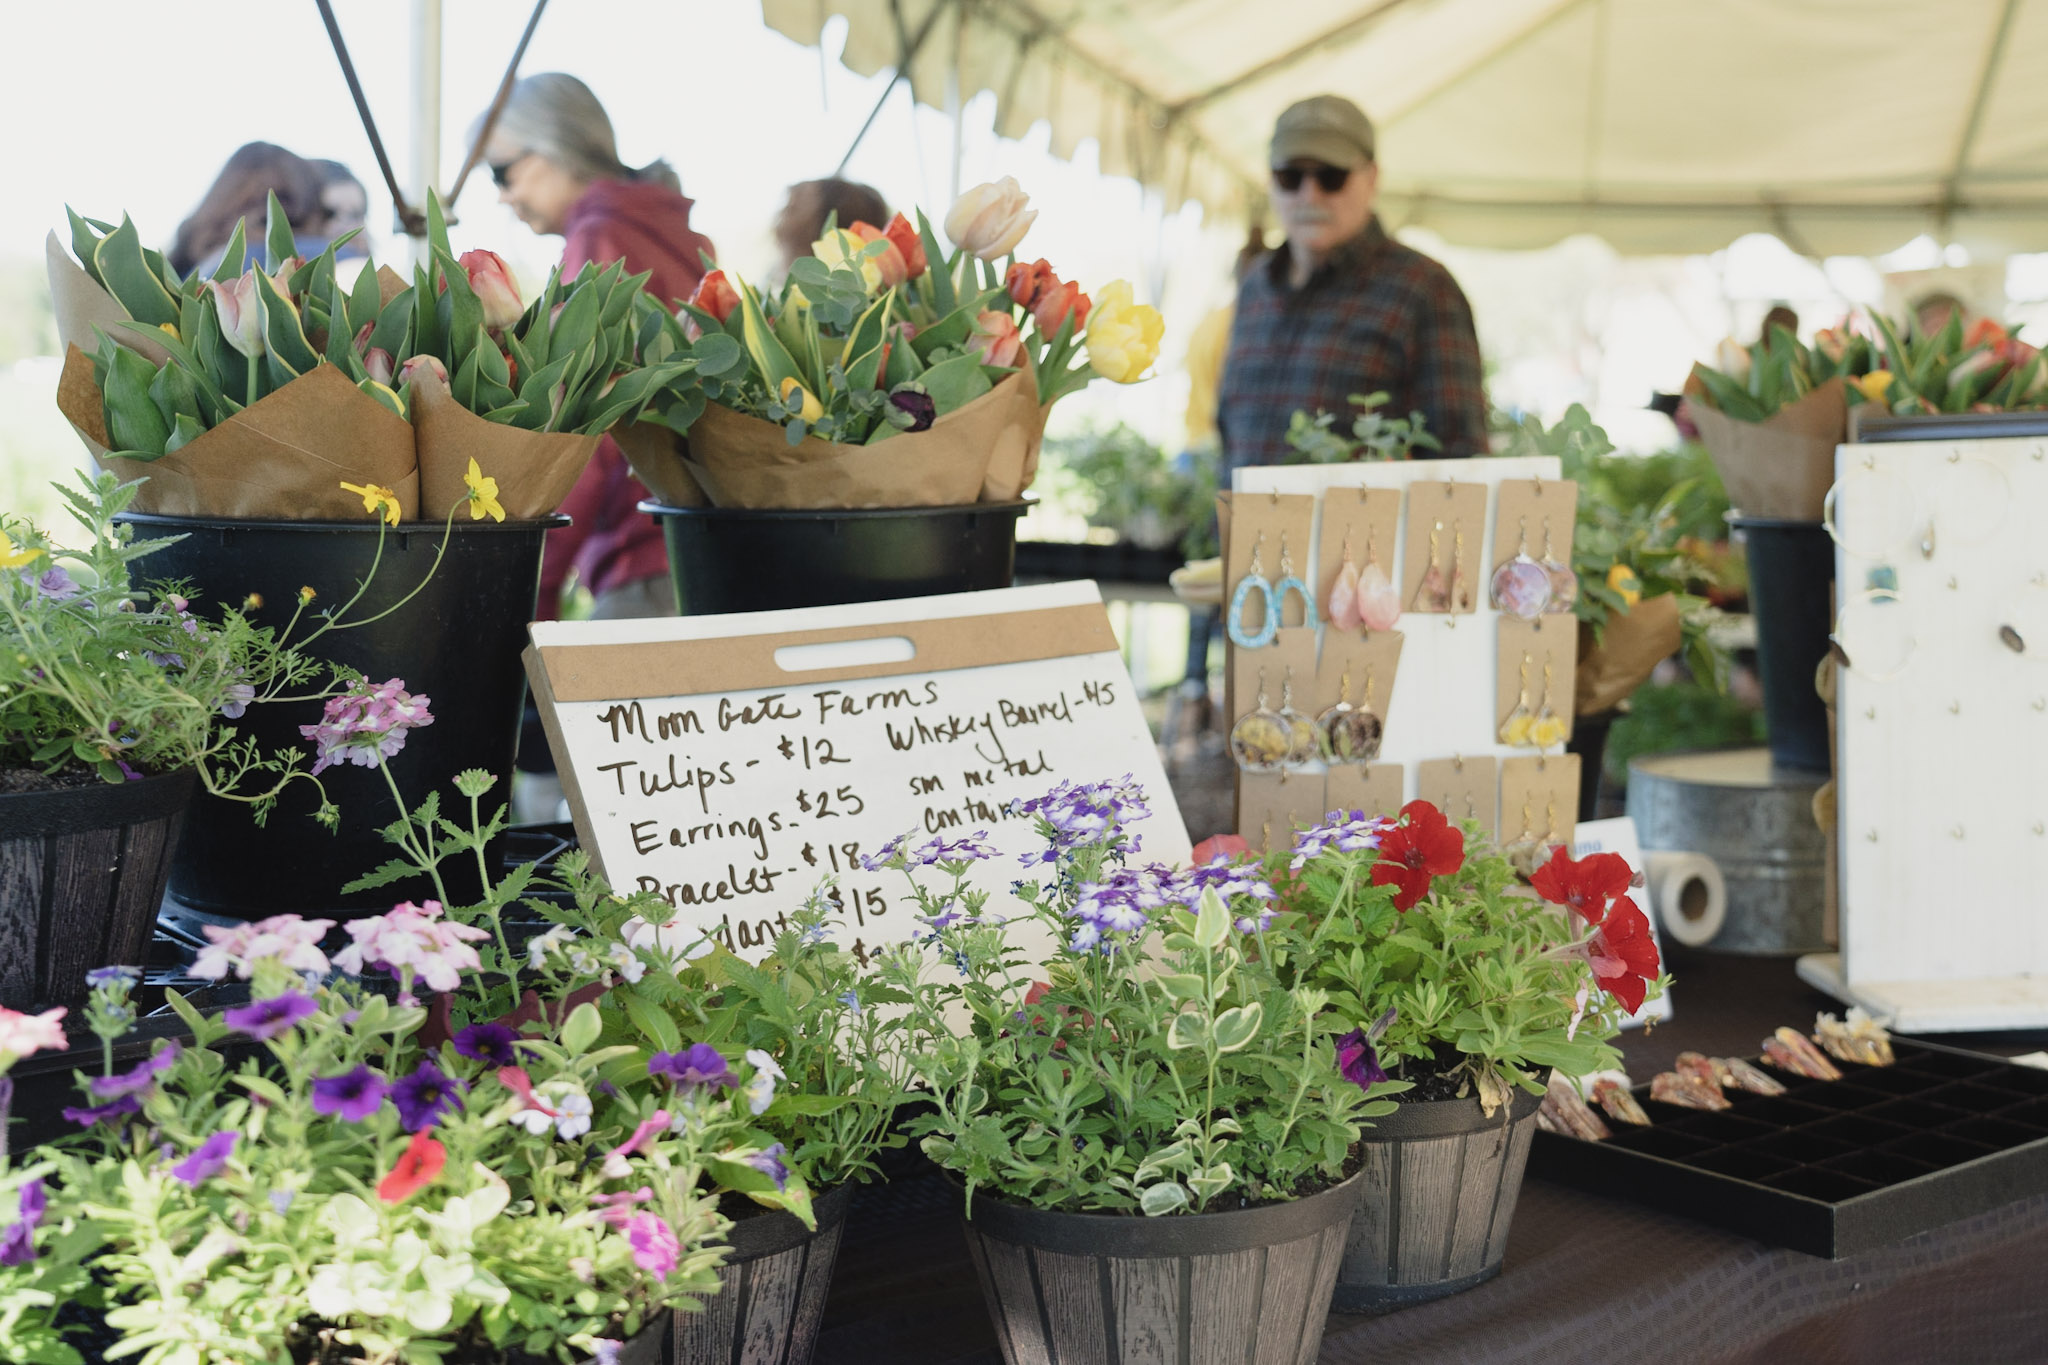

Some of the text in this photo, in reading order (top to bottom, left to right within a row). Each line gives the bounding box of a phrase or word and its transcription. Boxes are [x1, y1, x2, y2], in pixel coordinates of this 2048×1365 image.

[597, 681, 937, 743] Moon Gate Farms
[776, 734, 852, 770] $12
[886, 712, 1005, 764] Whiskey
[796, 785, 864, 819] $25
[801, 841, 861, 873] $18
[827, 886, 888, 927] $15
